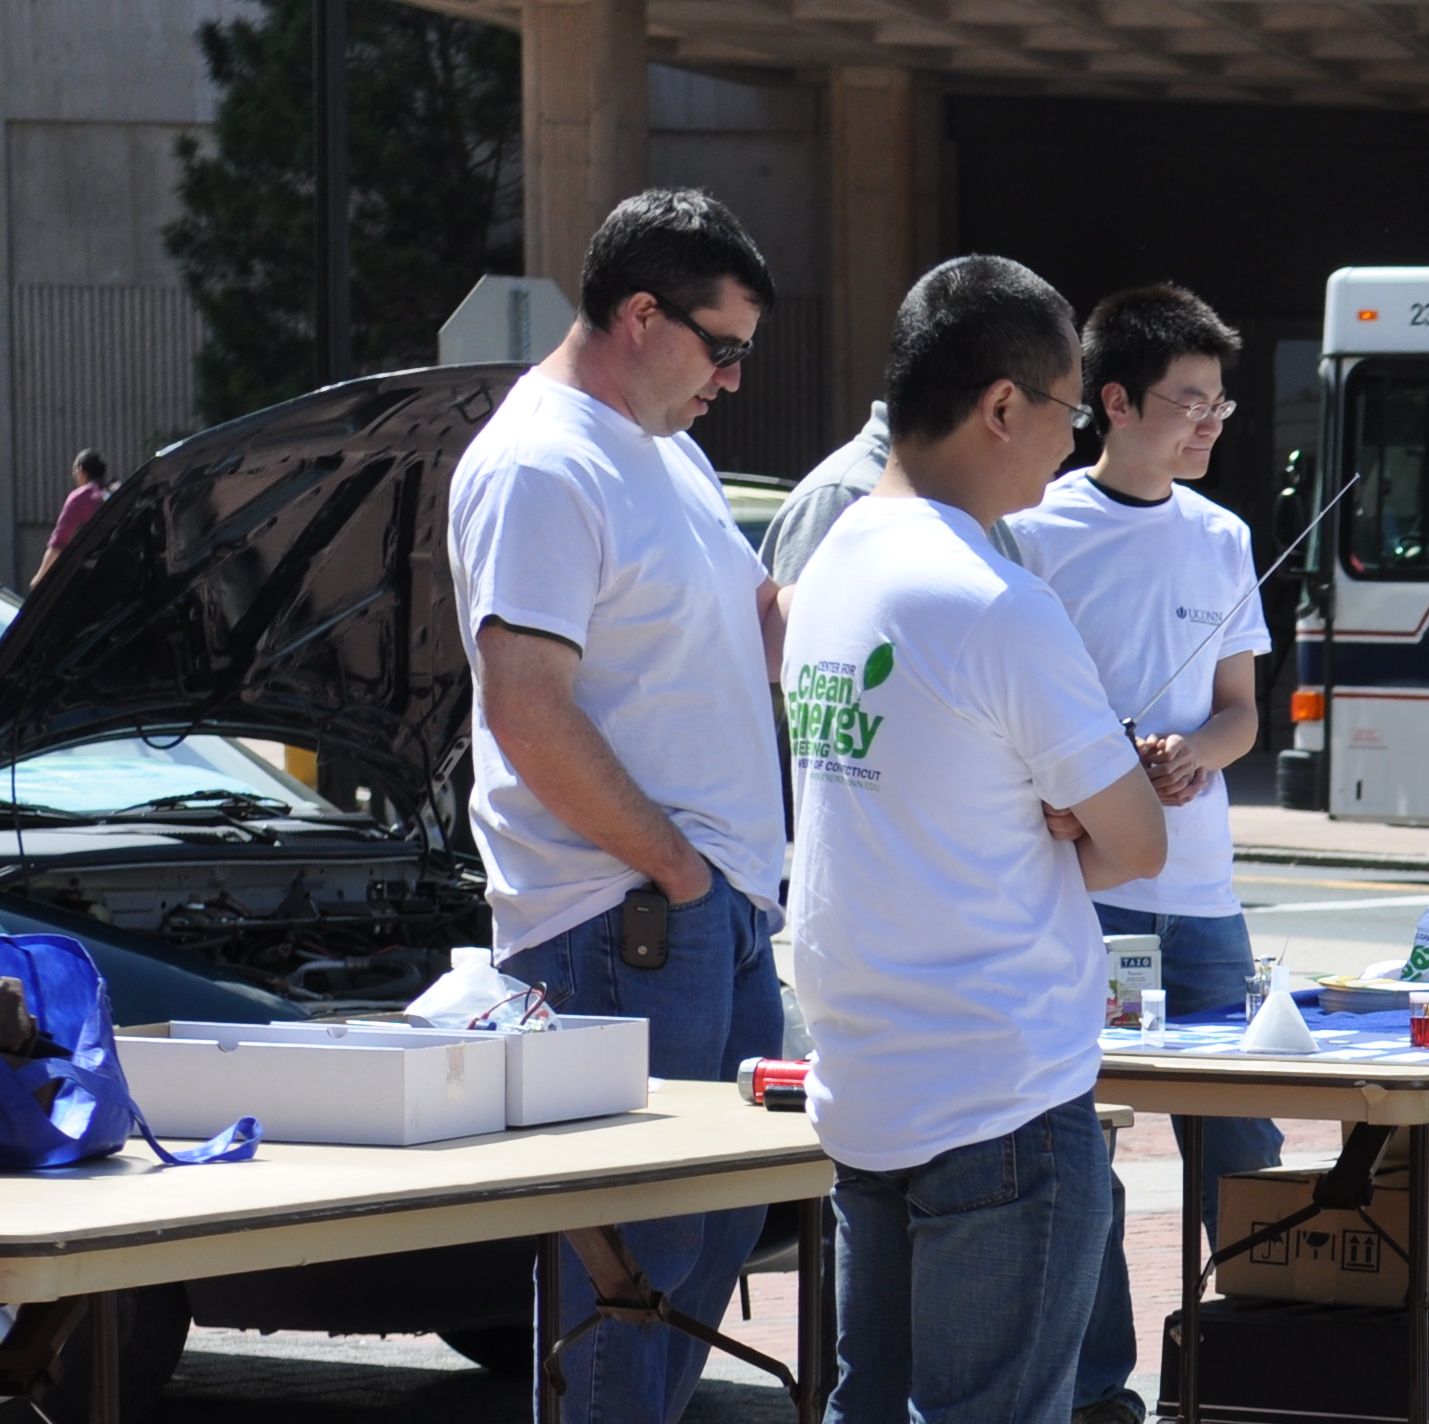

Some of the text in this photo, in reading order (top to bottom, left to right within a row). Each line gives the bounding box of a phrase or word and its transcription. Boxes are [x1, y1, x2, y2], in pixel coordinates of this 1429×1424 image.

[1188, 608, 1223, 622] UCONN
[841, 663, 857, 677] FOR
[798, 663, 854, 706] Clean
[788, 691, 885, 760] Energy
